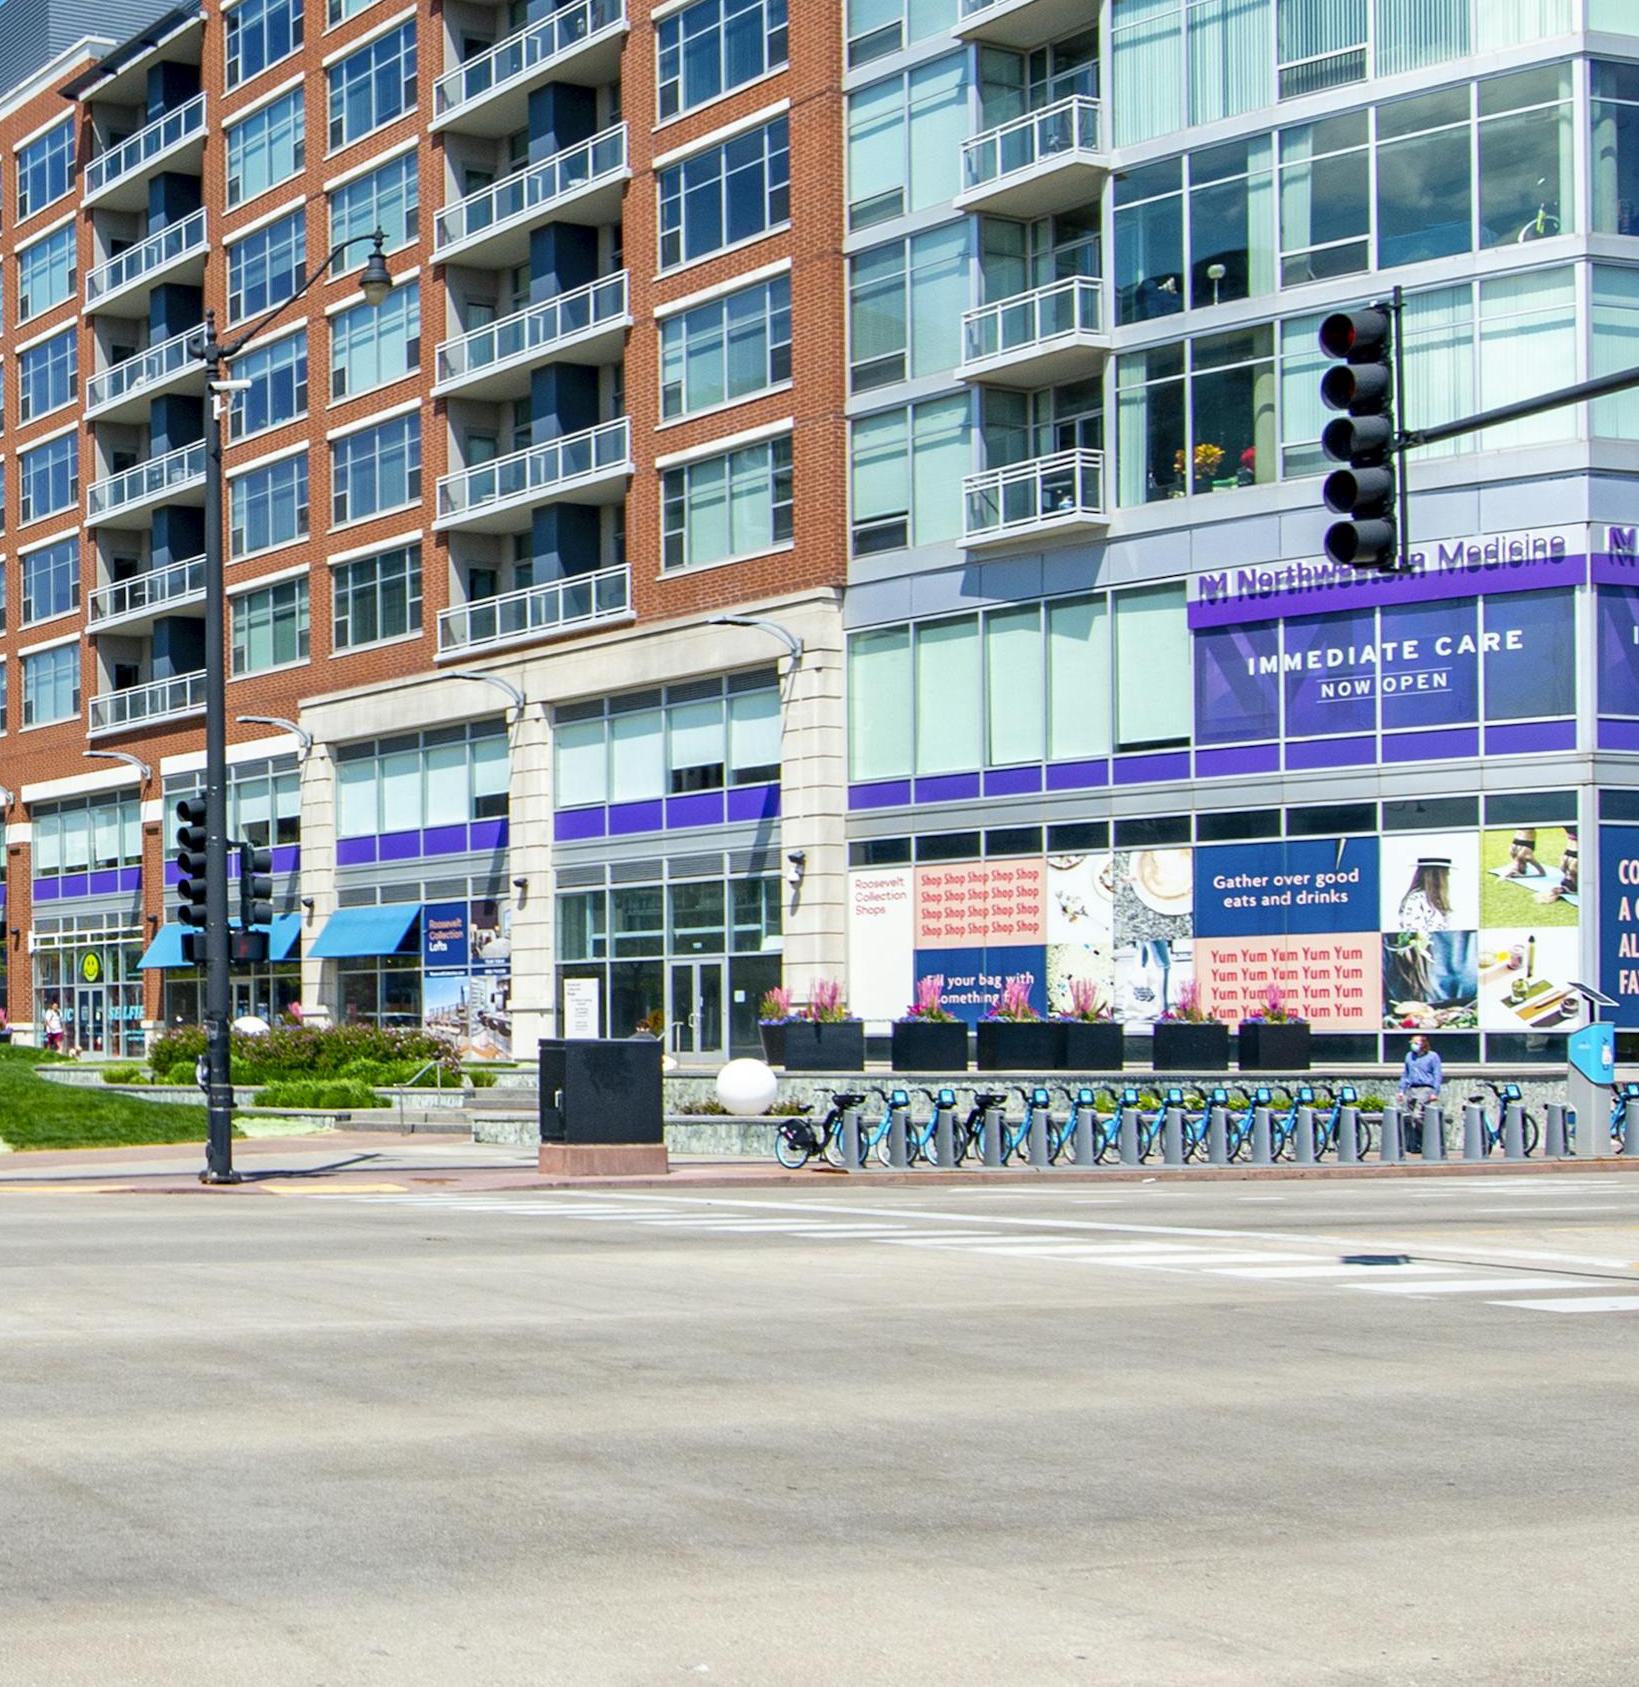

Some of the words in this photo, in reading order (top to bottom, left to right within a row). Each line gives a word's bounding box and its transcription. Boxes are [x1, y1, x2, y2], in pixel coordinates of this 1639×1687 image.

[1439, 534, 1565, 571] Medicine
[1248, 640, 1419, 676] IMMEDIATE
[1434, 630, 1523, 656] CARE
[1321, 679, 1371, 698] NOW
[1383, 672, 1447, 692] OPEN
[855, 877, 904, 889] Roosevelt
[921, 875, 941, 887] Shop
[944, 873, 965, 886] Shop
[968, 872, 989, 885] Shop
[992, 870, 1013, 883] Shop
[1016, 868, 1039, 882] Shop
[1213, 874, 1268, 889] Gather
[1273, 874, 1311, 887] over
[1315, 868, 1359, 888] good
[855, 891, 907, 903] Collection
[921, 891, 941, 905] Shop
[944, 891, 965, 903] Shop
[968, 889, 989, 902] Shop
[992, 888, 1013, 900] Shop
[1016, 886, 1039, 899] Shop
[1223, 895, 1257, 908] eats
[1261, 891, 1292, 906] and
[1296, 889, 1349, 905] drinks
[855, 906, 886, 917] Shops
[921, 909, 941, 921] Shop
[944, 907, 965, 920] Shop
[968, 906, 989, 919] Shop
[992, 905, 1013, 918] Shop
[1016, 903, 1039, 916] Shop
[1618, 896, 1632, 922] A
[921, 925, 941, 938] Shop
[944, 924, 965, 937] Shop
[968, 923, 989, 936] Shop
[992, 922, 1013, 935] Shop
[1016, 921, 1039, 934] Shop
[1211, 950, 1237, 963] Yum
[1241, 949, 1267, 962] Yum
[1272, 948, 1298, 961] Yum
[1303, 947, 1330, 960] Yum
[1334, 947, 1362, 959] Yum
[947, 975, 976, 989] your
[979, 973, 1002, 989] bag
[1005, 972, 1034, 985] with
[1211, 969, 1237, 982] Yum
[1241, 968, 1267, 980] Yum
[1272, 967, 1298, 980] Yum
[1303, 966, 1330, 979] Yum
[1334, 966, 1362, 978] Yum
[938, 992, 999, 1008] omething
[1211, 987, 1237, 1000] Yum
[1241, 987, 1267, 999] Yum
[1303, 986, 1330, 998] Yum
[1334, 984, 1362, 997] Yum
[1211, 1006, 1237, 1018] Yum
[1303, 1004, 1330, 1017] Yum
[1334, 1004, 1362, 1016] Yum
